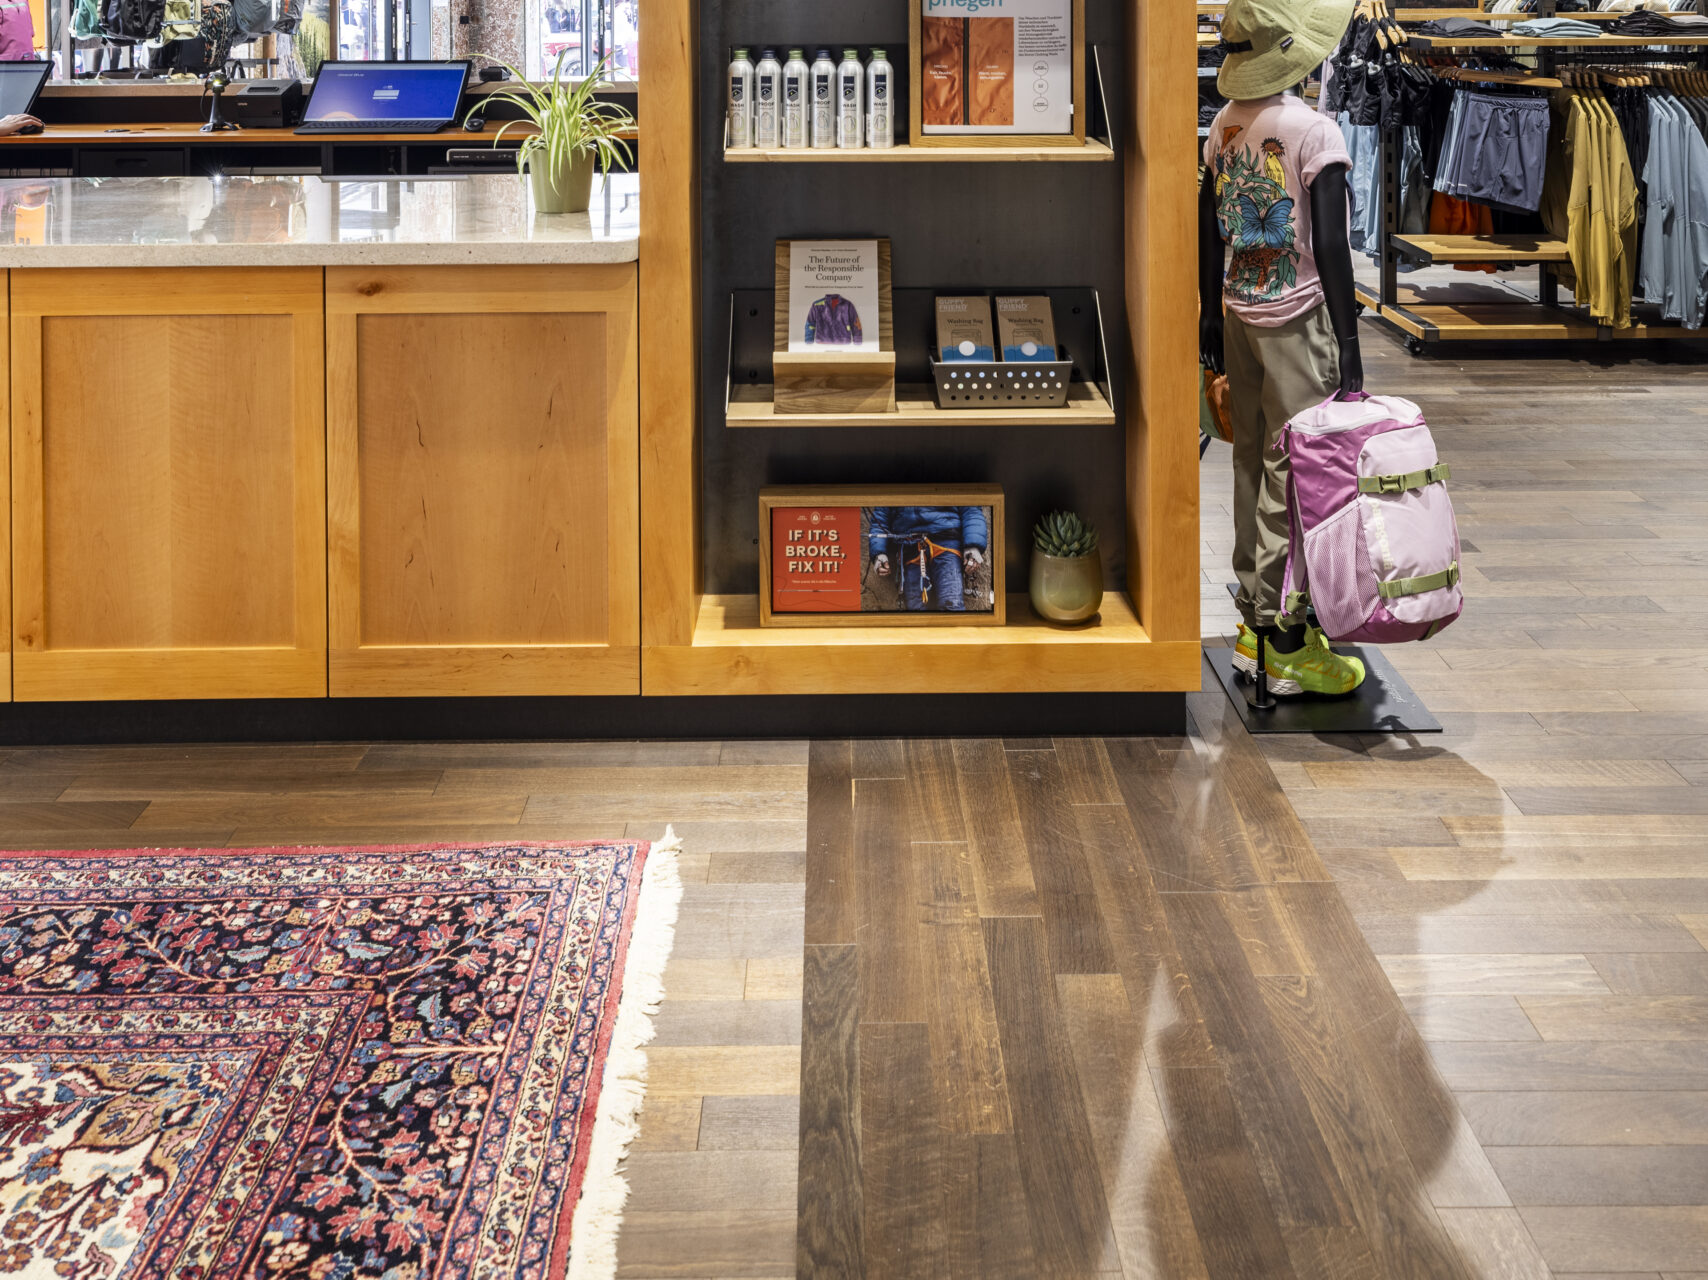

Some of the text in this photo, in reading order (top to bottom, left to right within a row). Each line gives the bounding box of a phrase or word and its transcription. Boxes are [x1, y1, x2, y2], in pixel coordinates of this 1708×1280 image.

[808, 255, 861, 264] The Future of
[804, 264, 864, 274] the Responsible
[815, 273, 853, 283] Company
[788, 529, 838, 541] IF IT’S
[785, 545, 846, 559] BROKE,
[788, 561, 814, 573] FIX
